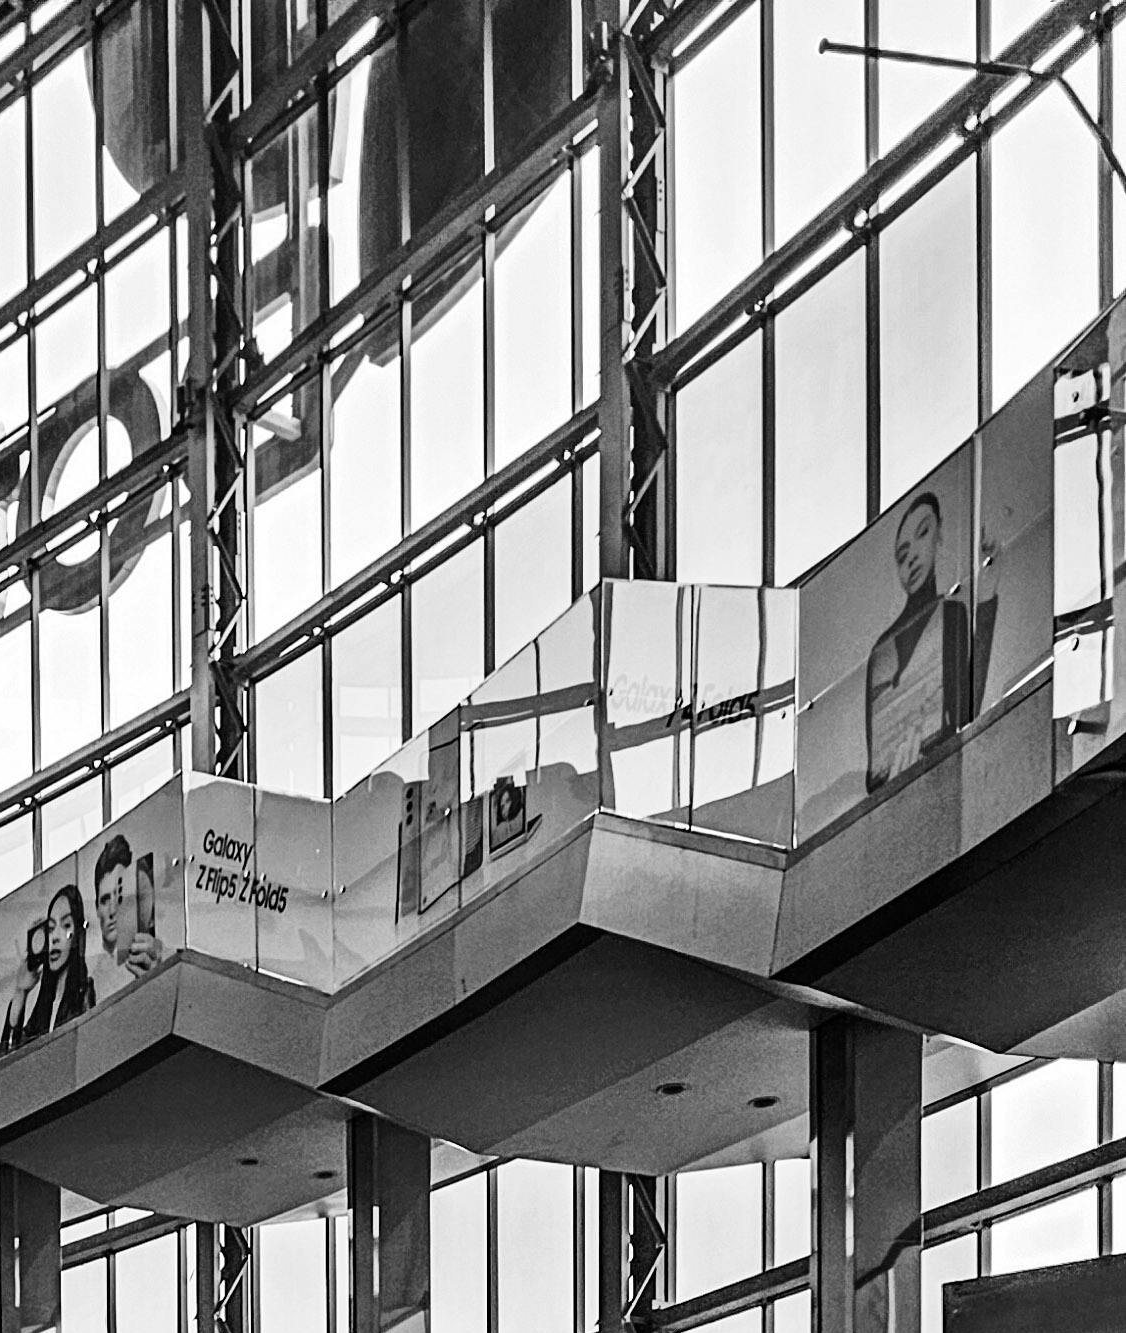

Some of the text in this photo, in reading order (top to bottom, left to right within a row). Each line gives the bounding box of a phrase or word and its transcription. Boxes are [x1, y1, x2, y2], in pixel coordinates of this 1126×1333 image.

[203, 829, 253, 871] Galaxy
[195, 864, 206, 889] Z
[205, 866, 237, 904] Flip5
[248, 875, 289, 913] Fold5
